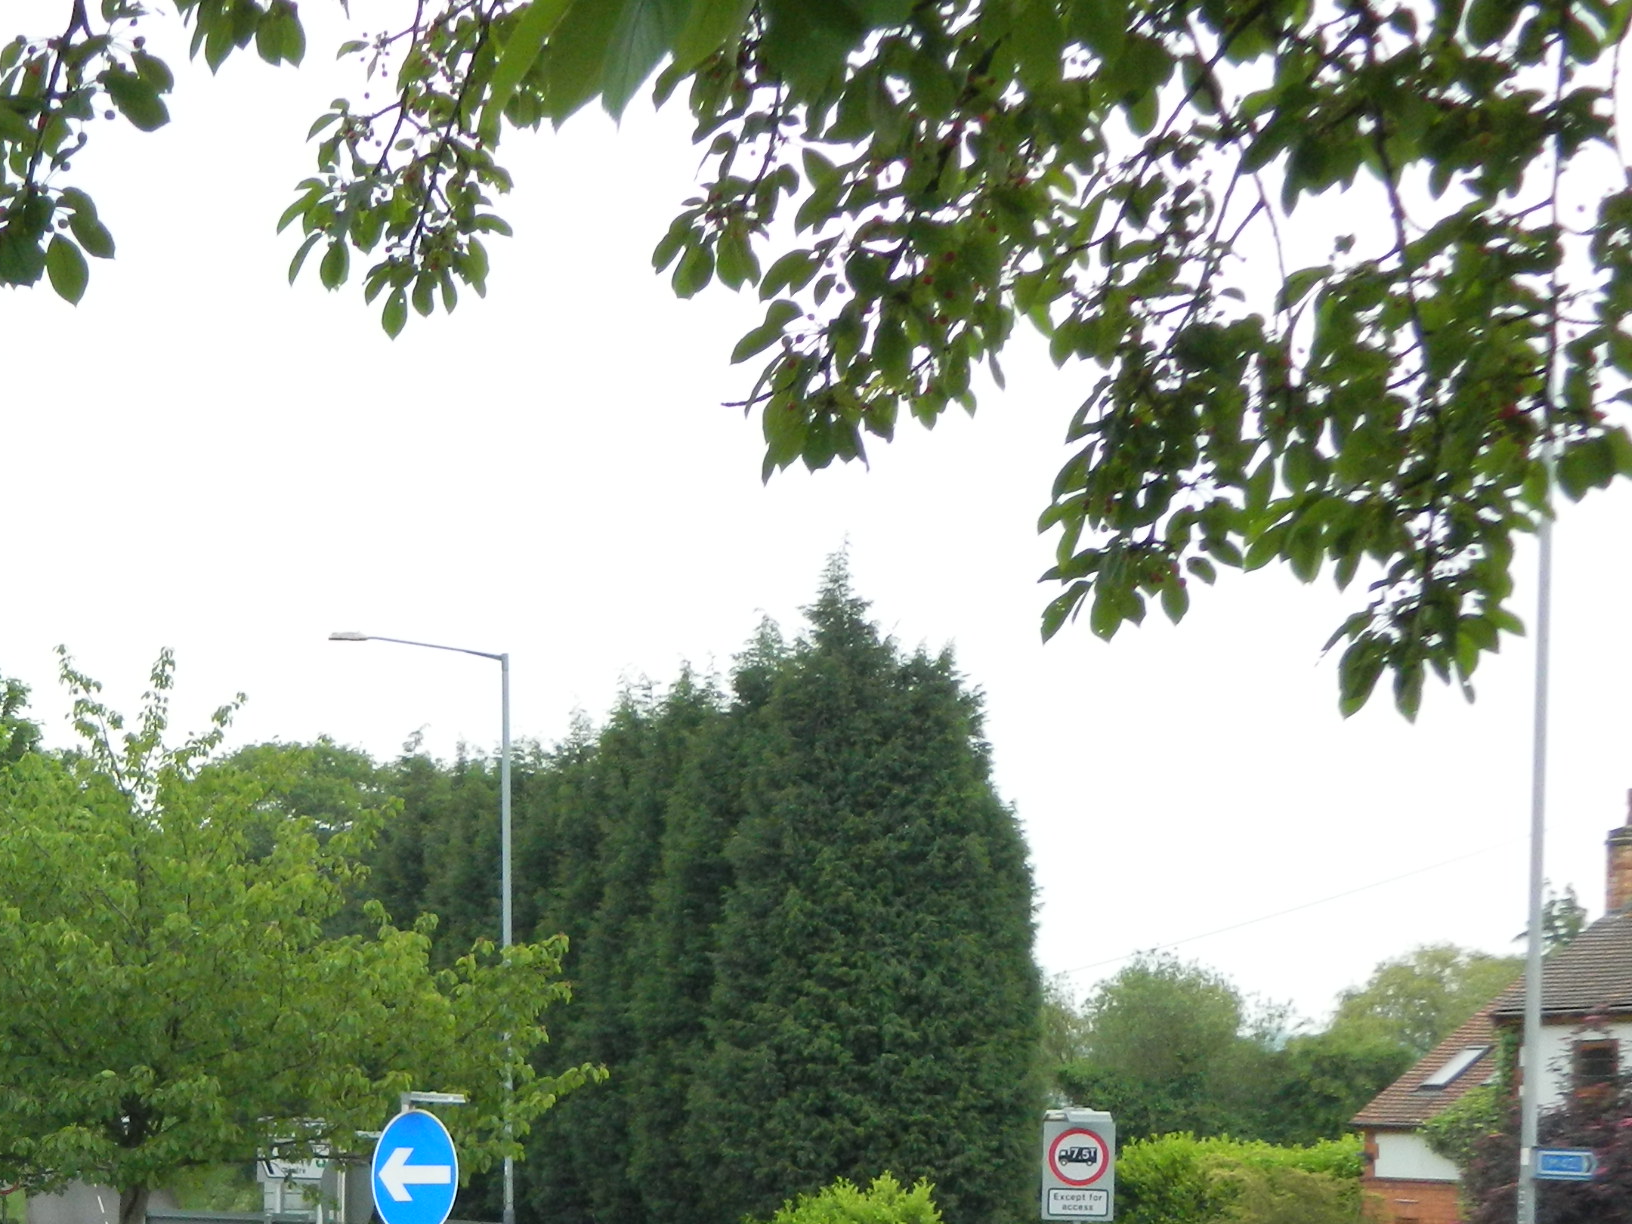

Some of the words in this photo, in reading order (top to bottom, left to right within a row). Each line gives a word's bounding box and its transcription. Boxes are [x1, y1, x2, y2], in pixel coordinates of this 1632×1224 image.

[1070, 1147, 1096, 1160] 7.5T
[1053, 1193, 1086, 1202] Except
[1089, 1193, 1103, 1202] for
